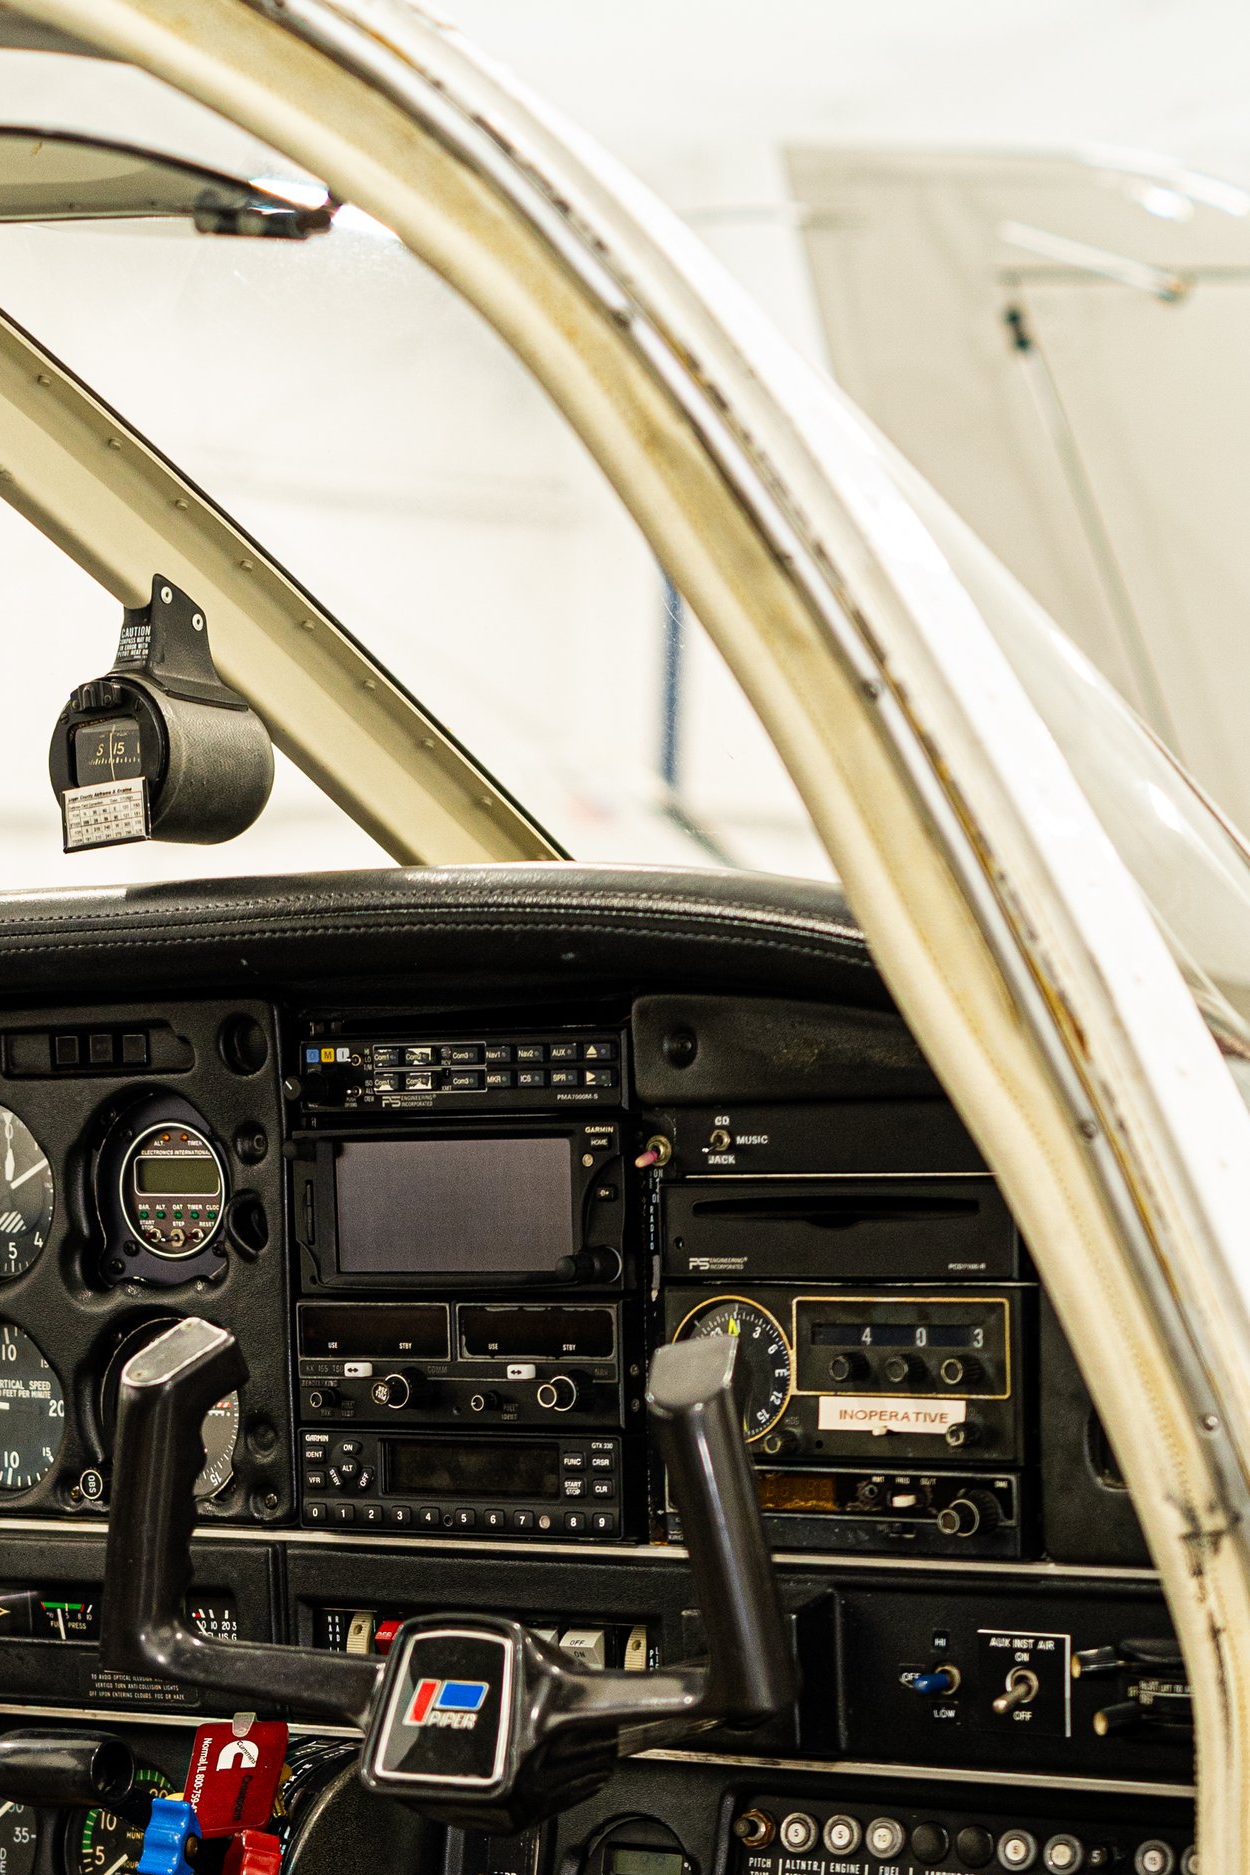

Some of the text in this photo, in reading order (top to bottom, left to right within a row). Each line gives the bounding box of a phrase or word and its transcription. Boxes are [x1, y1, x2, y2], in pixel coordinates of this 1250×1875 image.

[121, 625, 151, 639] CAUTION
[96, 742, 125, 756] S 15
[374, 1053, 390, 1061] Com1
[405, 1053, 422, 1061] Com2
[452, 1052, 469, 1060] Com3
[485, 1051, 501, 1059] Nav1
[518, 1050, 534, 1059] Nav2
[552, 1049, 566, 1057] AUX
[374, 1078, 390, 1087] Com1
[405, 1077, 422, 1085] Com2
[452, 1077, 469, 1085] Com3
[486, 1075, 502, 1083] MKR
[519, 1074, 532, 1083] ICS
[552, 1074, 567, 1082] SPR
[714, 1115, 730, 1126] CD
[736, 1135, 768, 1144] MUSIC
[708, 1154, 736, 1165] JACK
[33, 1231, 44, 1248] 4
[8, 1242, 18, 1260] 5
[861, 1327, 984, 1348] 4 0 3
[327, 1341, 412, 1350] USE STBY
[2, 1344, 18, 1362] 10
[28, 1380, 52, 1391] SPEED
[5, 1389, 17, 1397] FEET
[18, 1390, 30, 1398] PER
[31, 1390, 52, 1399] MINUTE
[48, 1400, 65, 1418] 20
[838, 1409, 950, 1424] INOPERATIVE
[305, 1434, 329, 1442] GARMIN
[3, 1450, 20, 1469] 10
[563, 1458, 581, 1466] FUNC
[592, 1458, 610, 1466] CRSR
[342, 1464, 354, 1472] ALT
[88, 1475, 97, 1494] OBS
[308, 1476, 321, 1484] VFR
[595, 1485, 608, 1493] CLR
[68, 1621, 87, 1630] PRESS
[568, 1638, 586, 1647] OFF
[934, 1637, 947, 1647] HI
[1037, 1640, 1055, 1650] AIR
[1014, 1652, 1030, 1662] ON
[113, 1674, 131, 1682] OPTICAL
[114, 1682, 127, 1690] TURN
[163, 1684, 179, 1692] LIGHTS
[112, 1690, 133, 1698] ENTERING
[173, 1693, 185, 1701] HAZE
[933, 1709, 956, 1719] LOW
[1012, 1711, 1033, 1722] OFF
[426, 1711, 478, 1731] PIPER
[196, 1737, 213, 1766] Normal,
[236, 1741, 257, 1765] Cummins
[196, 1766, 207, 1774] IL
[94, 1846, 105, 1866] 5
[749, 1857, 772, 1868] PITCH
[830, 1862, 860, 1875] ENGINE
